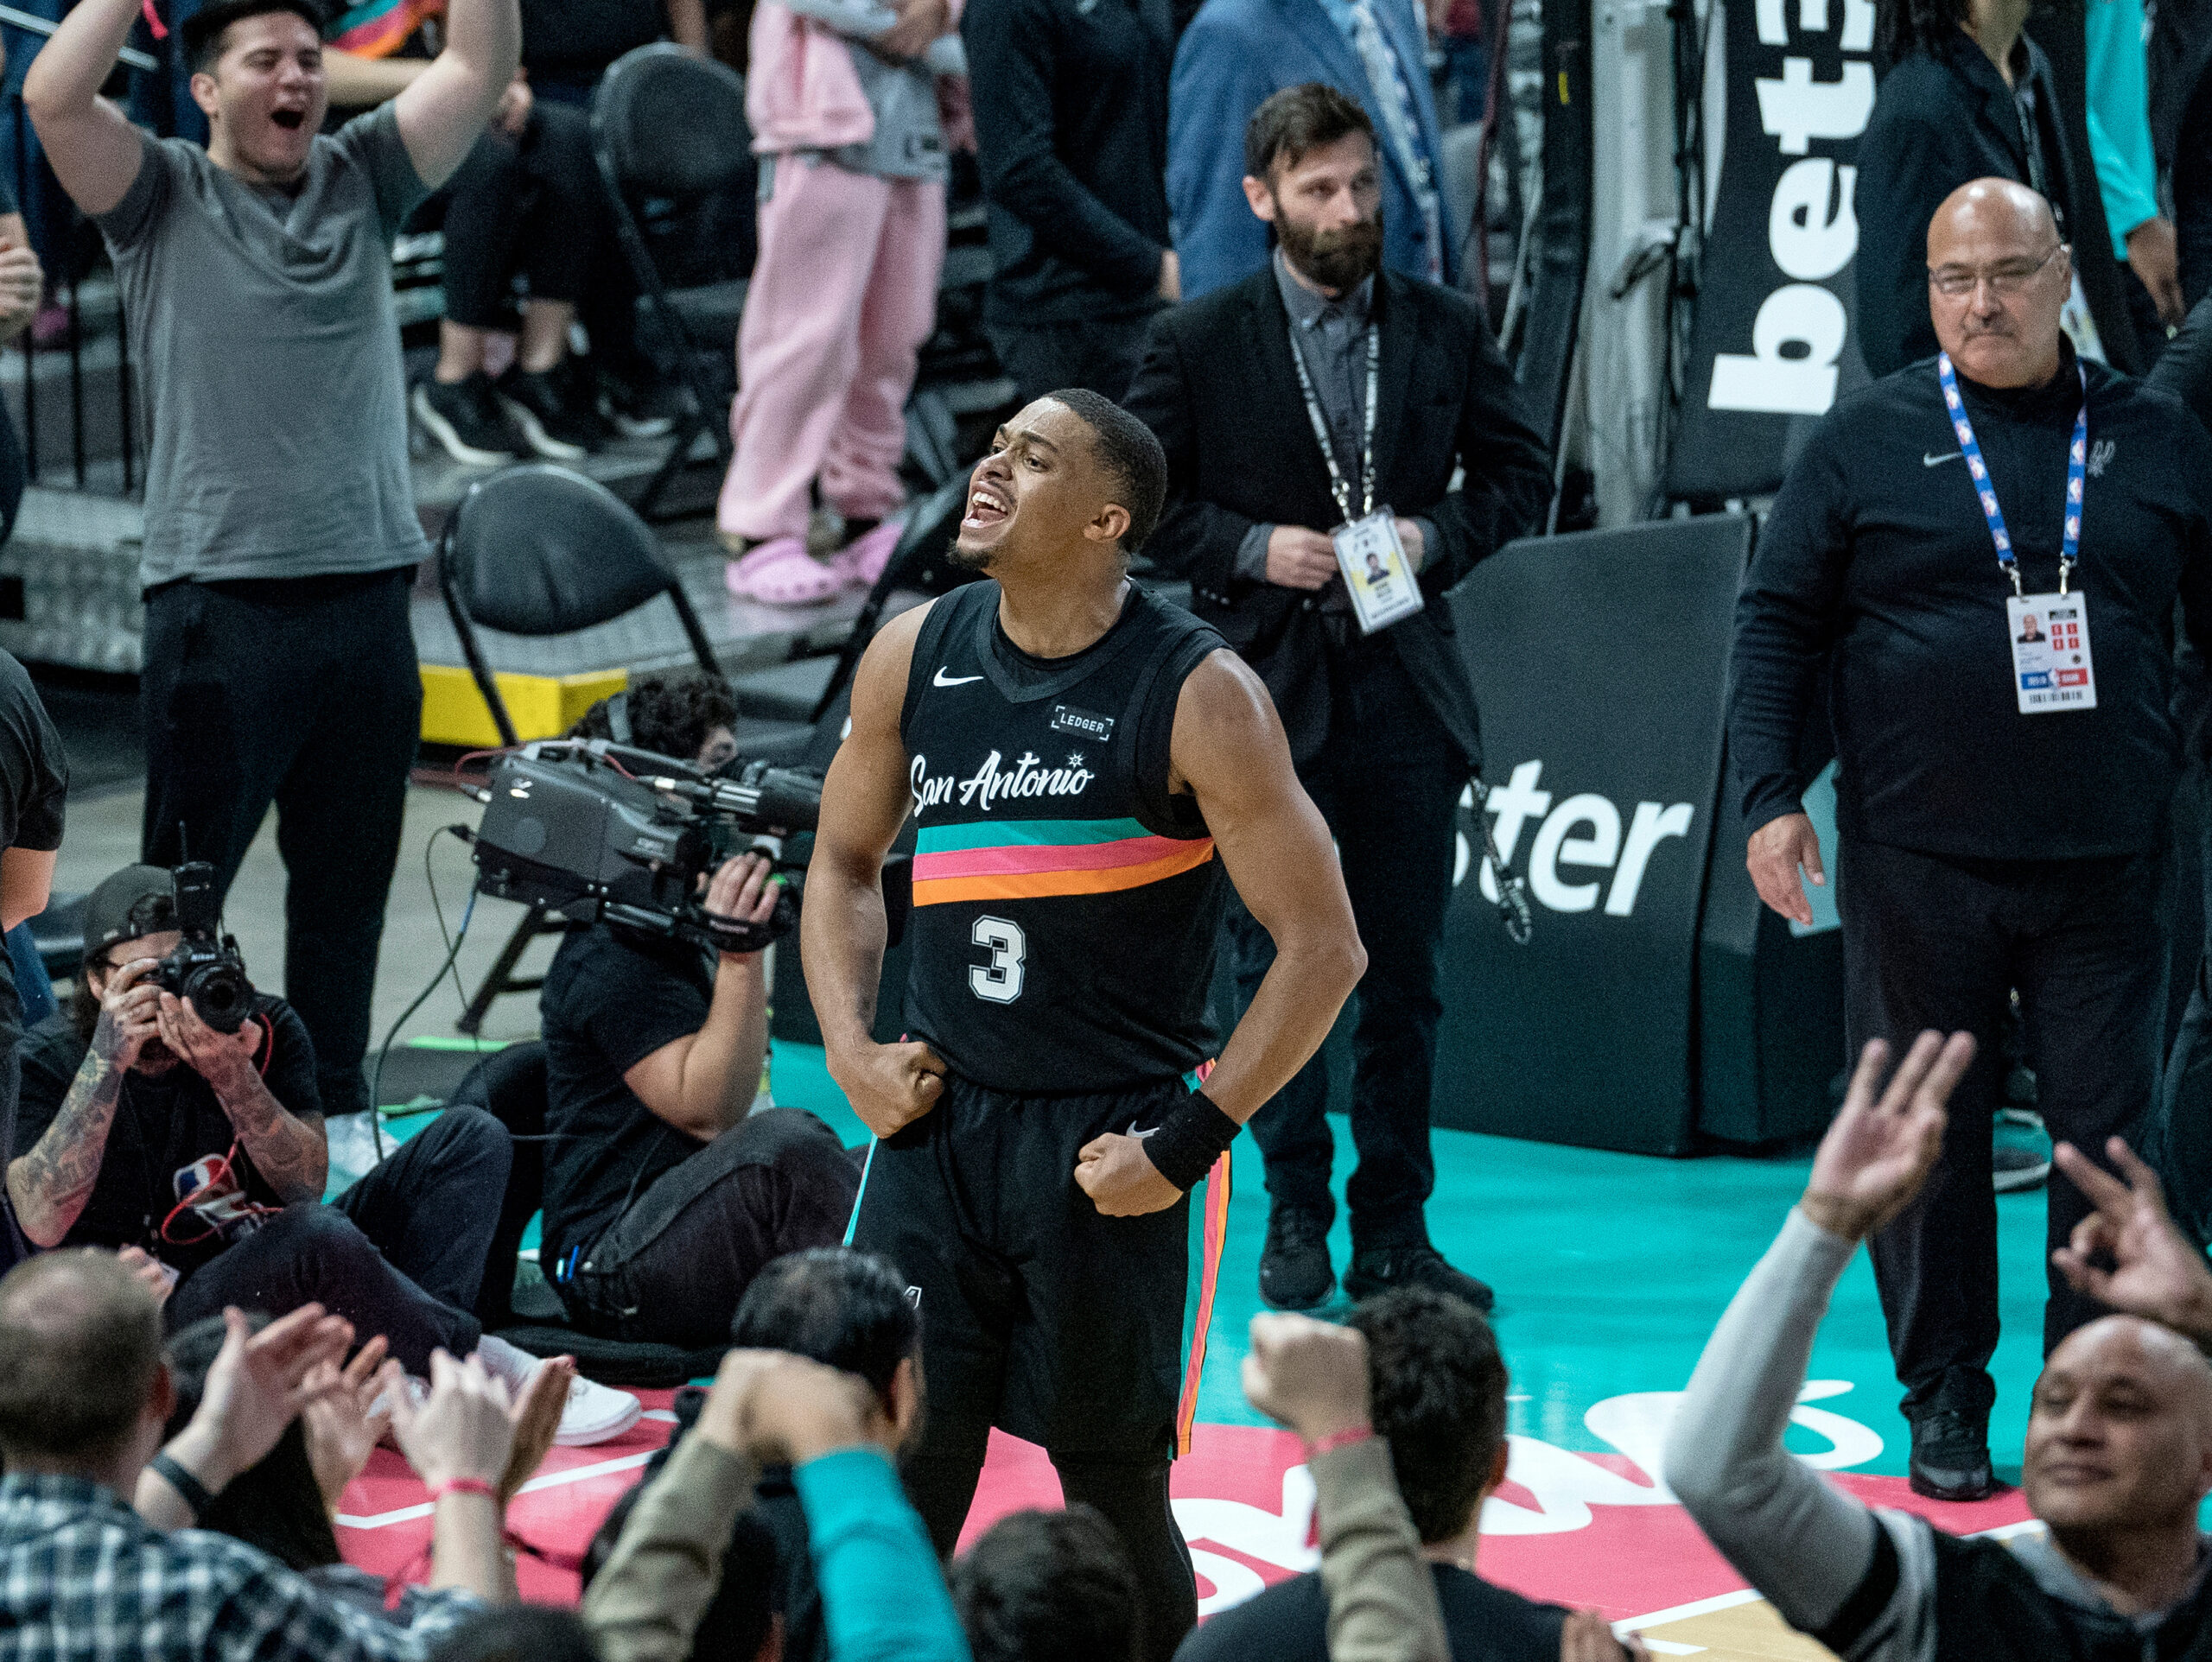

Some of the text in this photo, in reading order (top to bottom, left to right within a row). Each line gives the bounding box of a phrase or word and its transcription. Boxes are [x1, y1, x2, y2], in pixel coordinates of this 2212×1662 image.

[1060, 713, 1104, 733] LEDGER
[910, 749, 1095, 818] San Antonio
[969, 914, 1027, 1005] 3
